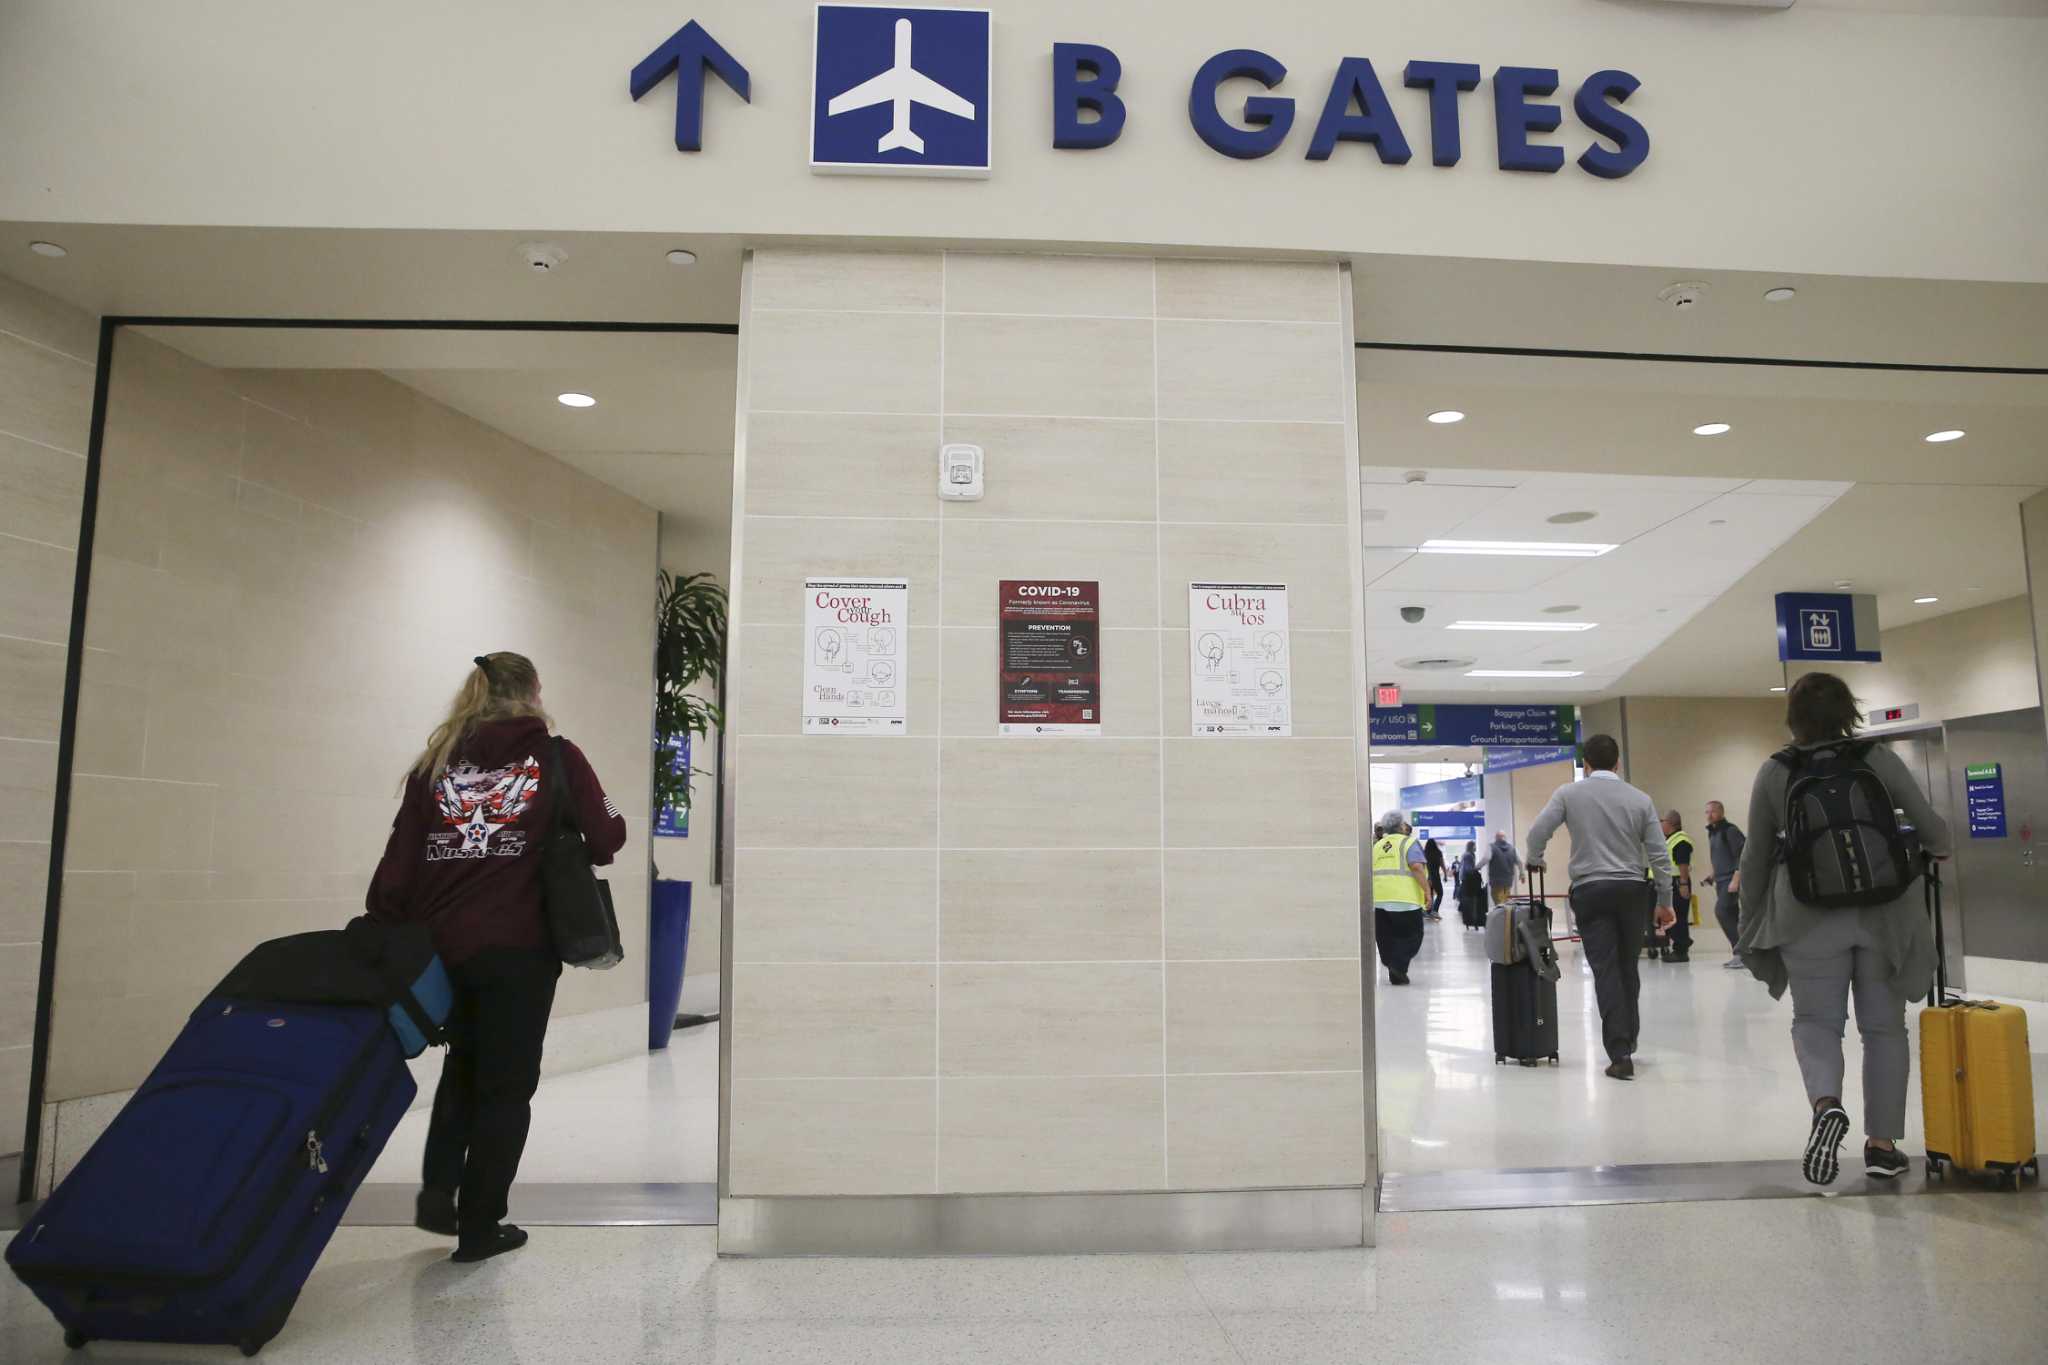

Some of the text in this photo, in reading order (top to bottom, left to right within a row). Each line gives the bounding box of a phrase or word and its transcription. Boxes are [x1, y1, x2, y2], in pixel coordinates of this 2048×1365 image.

[1053, 42, 1650, 179] B GATES
[1018, 586, 1080, 597] COVID-19
[815, 591, 871, 609] Cover
[1206, 593, 1265, 610] Cubra
[837, 608, 891, 627] Cough
[1241, 612, 1265, 625] tos
[1494, 708, 1547, 719] Baggage Claim
[1388, 715, 1406, 724] USO
[1489, 721, 1548, 732] Parking Garages
[1372, 732, 1406, 740] Restrooms
[1470, 734, 1548, 745] Ground Transportation
